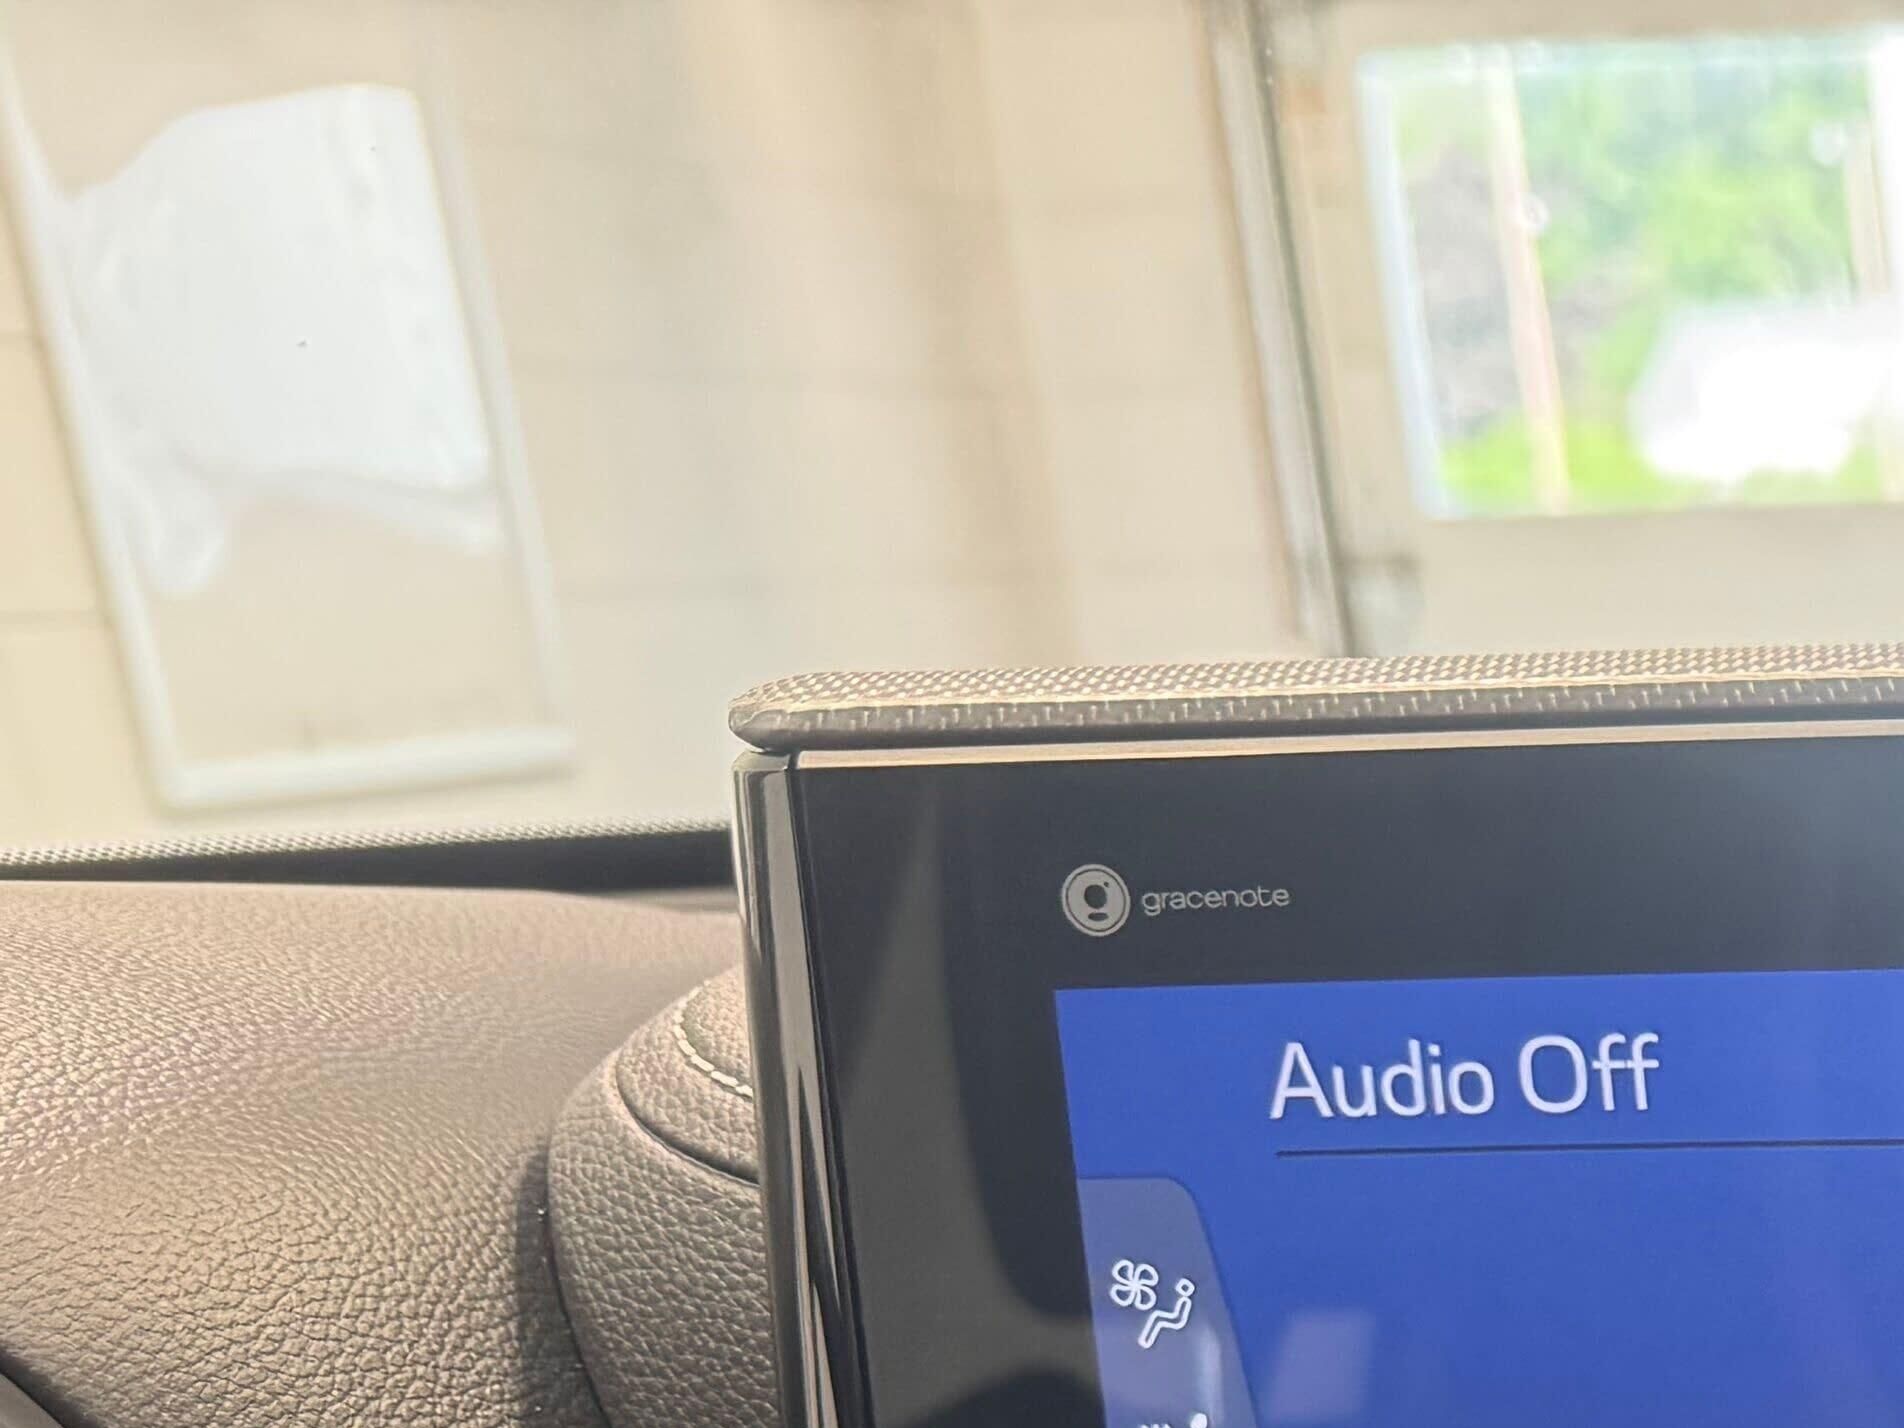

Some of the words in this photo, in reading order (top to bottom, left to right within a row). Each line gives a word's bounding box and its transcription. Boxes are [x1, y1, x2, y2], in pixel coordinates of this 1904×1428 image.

[1141, 882, 1291, 917] gracenote
[1268, 1038, 1496, 1120] Audio
[1516, 1031, 1661, 1114] Off
